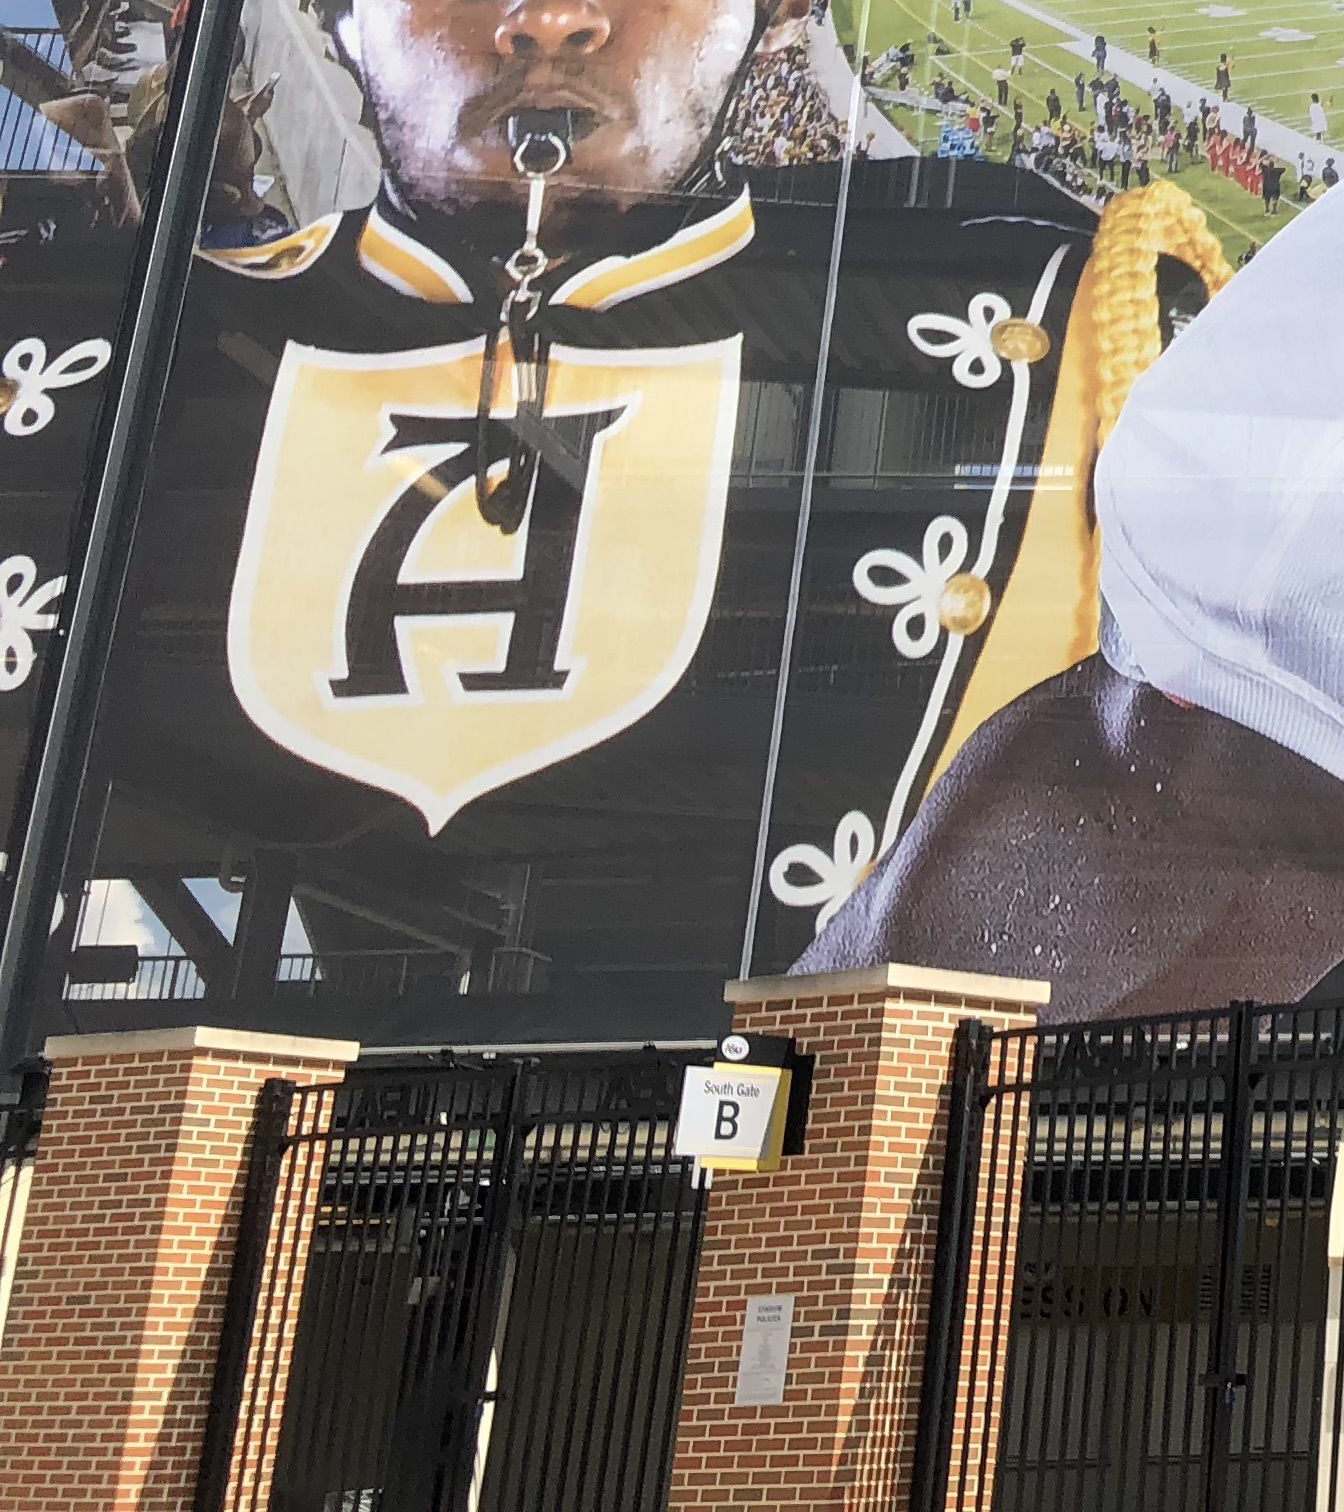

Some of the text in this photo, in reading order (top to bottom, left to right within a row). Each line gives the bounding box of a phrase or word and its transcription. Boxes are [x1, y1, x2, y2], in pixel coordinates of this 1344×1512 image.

[704, 1080, 760, 1098] South Gate
[714, 1099, 740, 1140] B
